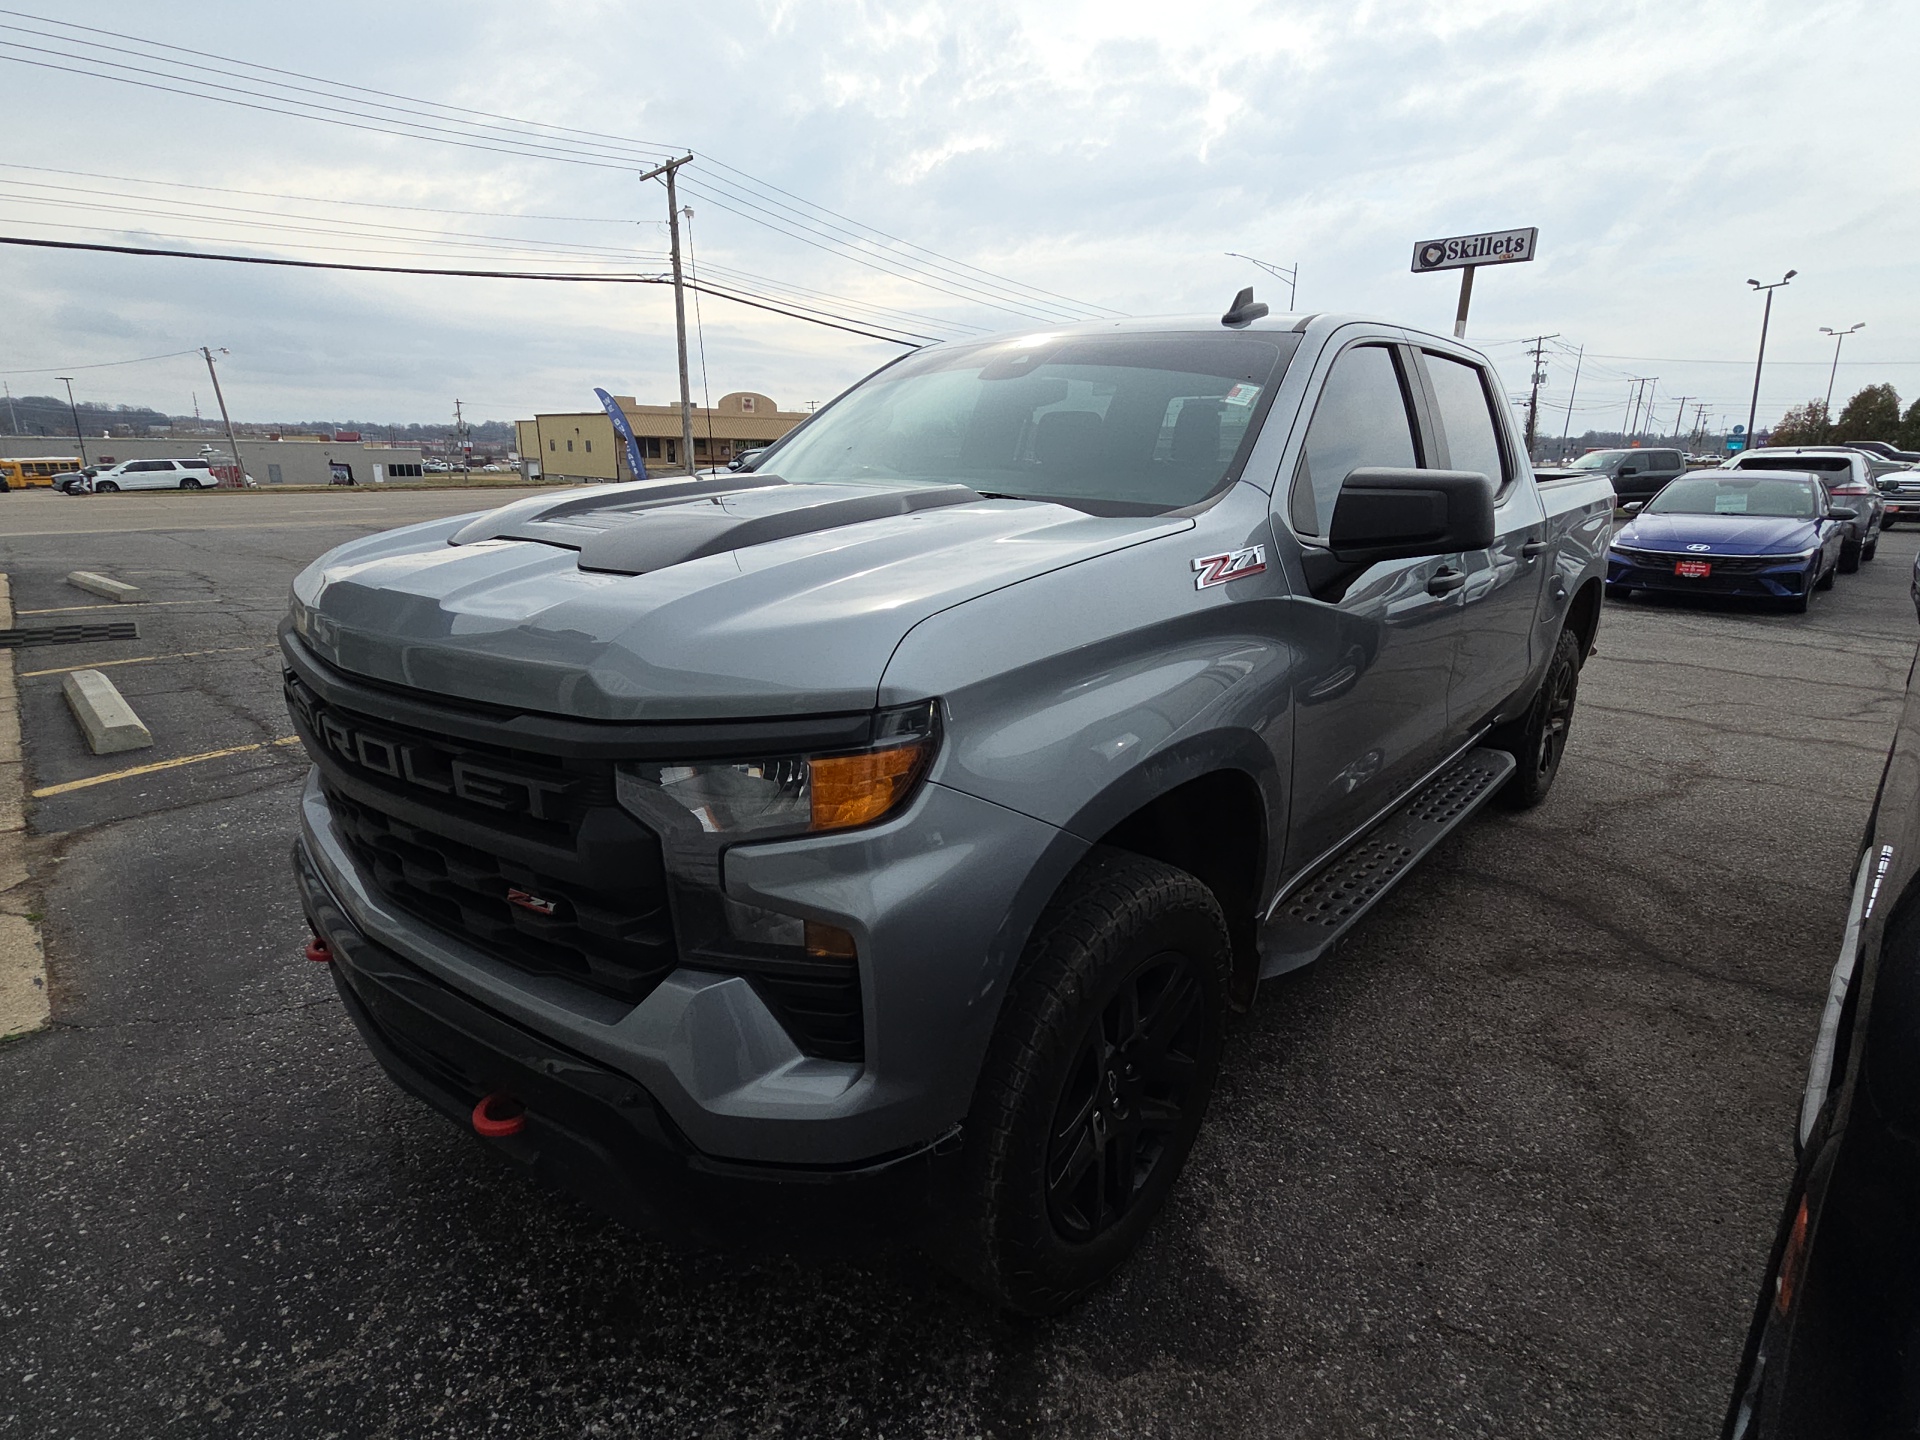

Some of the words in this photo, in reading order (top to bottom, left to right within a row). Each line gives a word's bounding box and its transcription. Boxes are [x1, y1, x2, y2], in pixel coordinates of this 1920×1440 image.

[1446, 235, 1525, 260] Skillets
[1190, 543, 1267, 591] Z71
[284, 668, 580, 822] EVROLET
